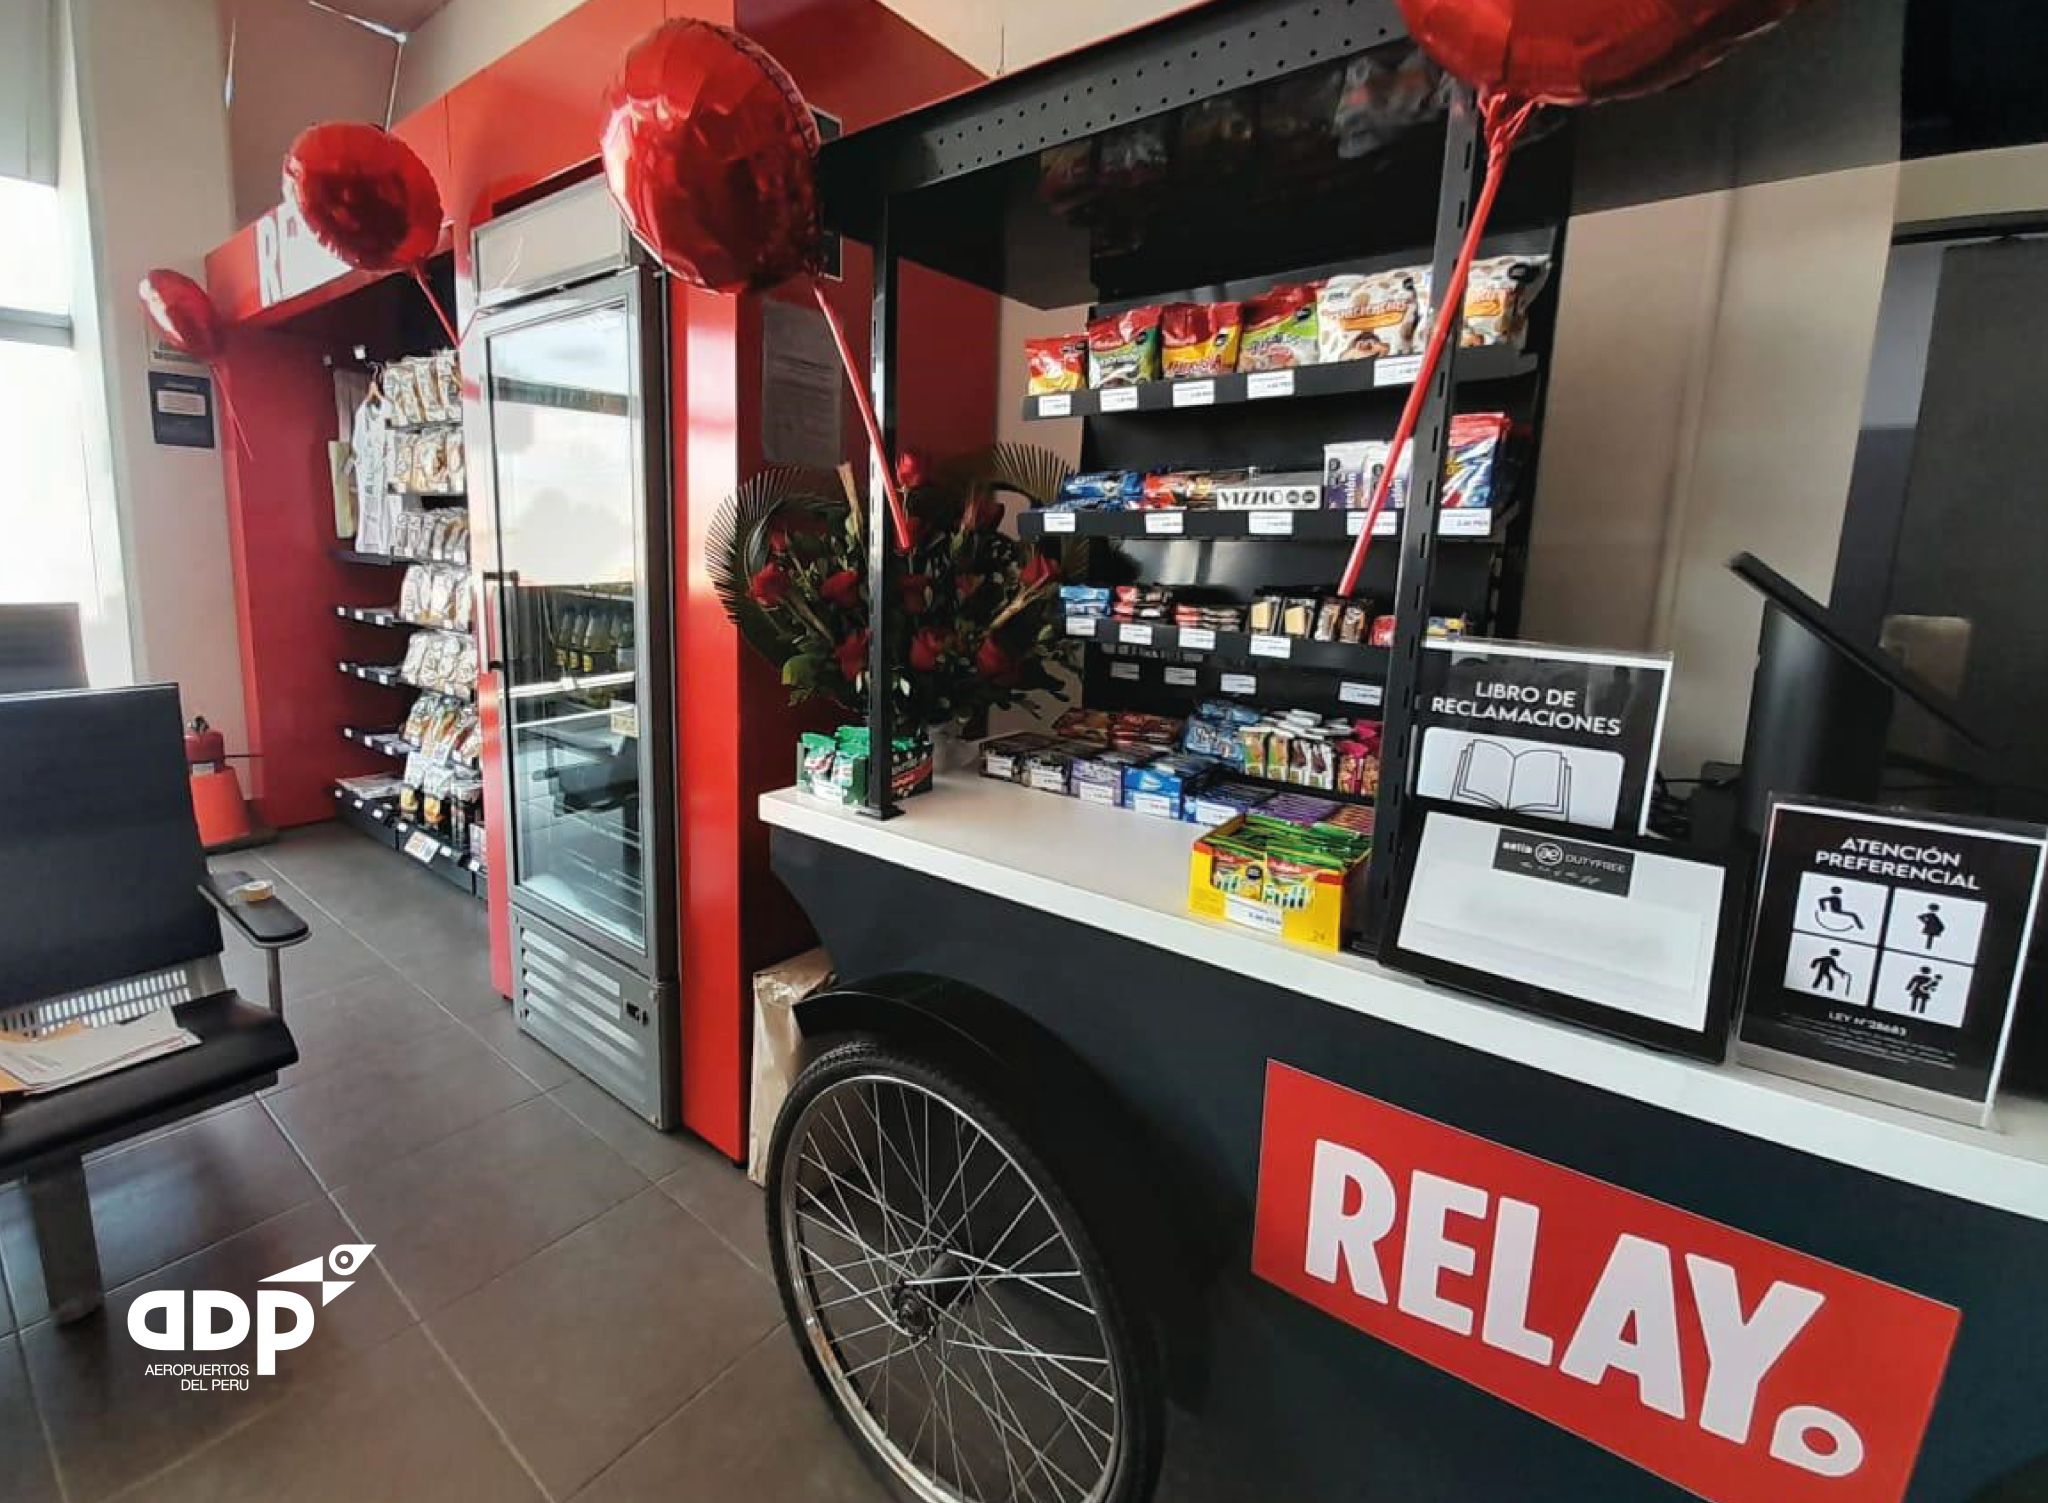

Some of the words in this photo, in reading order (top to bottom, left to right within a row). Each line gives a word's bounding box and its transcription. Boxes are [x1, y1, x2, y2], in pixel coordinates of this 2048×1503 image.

[1475, 680, 1541, 706] LIBRO
[1546, 688, 1576, 709] DE
[1431, 697, 1622, 736] RECLAMACIONES
[1841, 837, 1960, 867] ATENCIÓN
[1816, 852, 1980, 889] PREFERENCIAL
[1828, 1010, 1851, 1024] LEY
